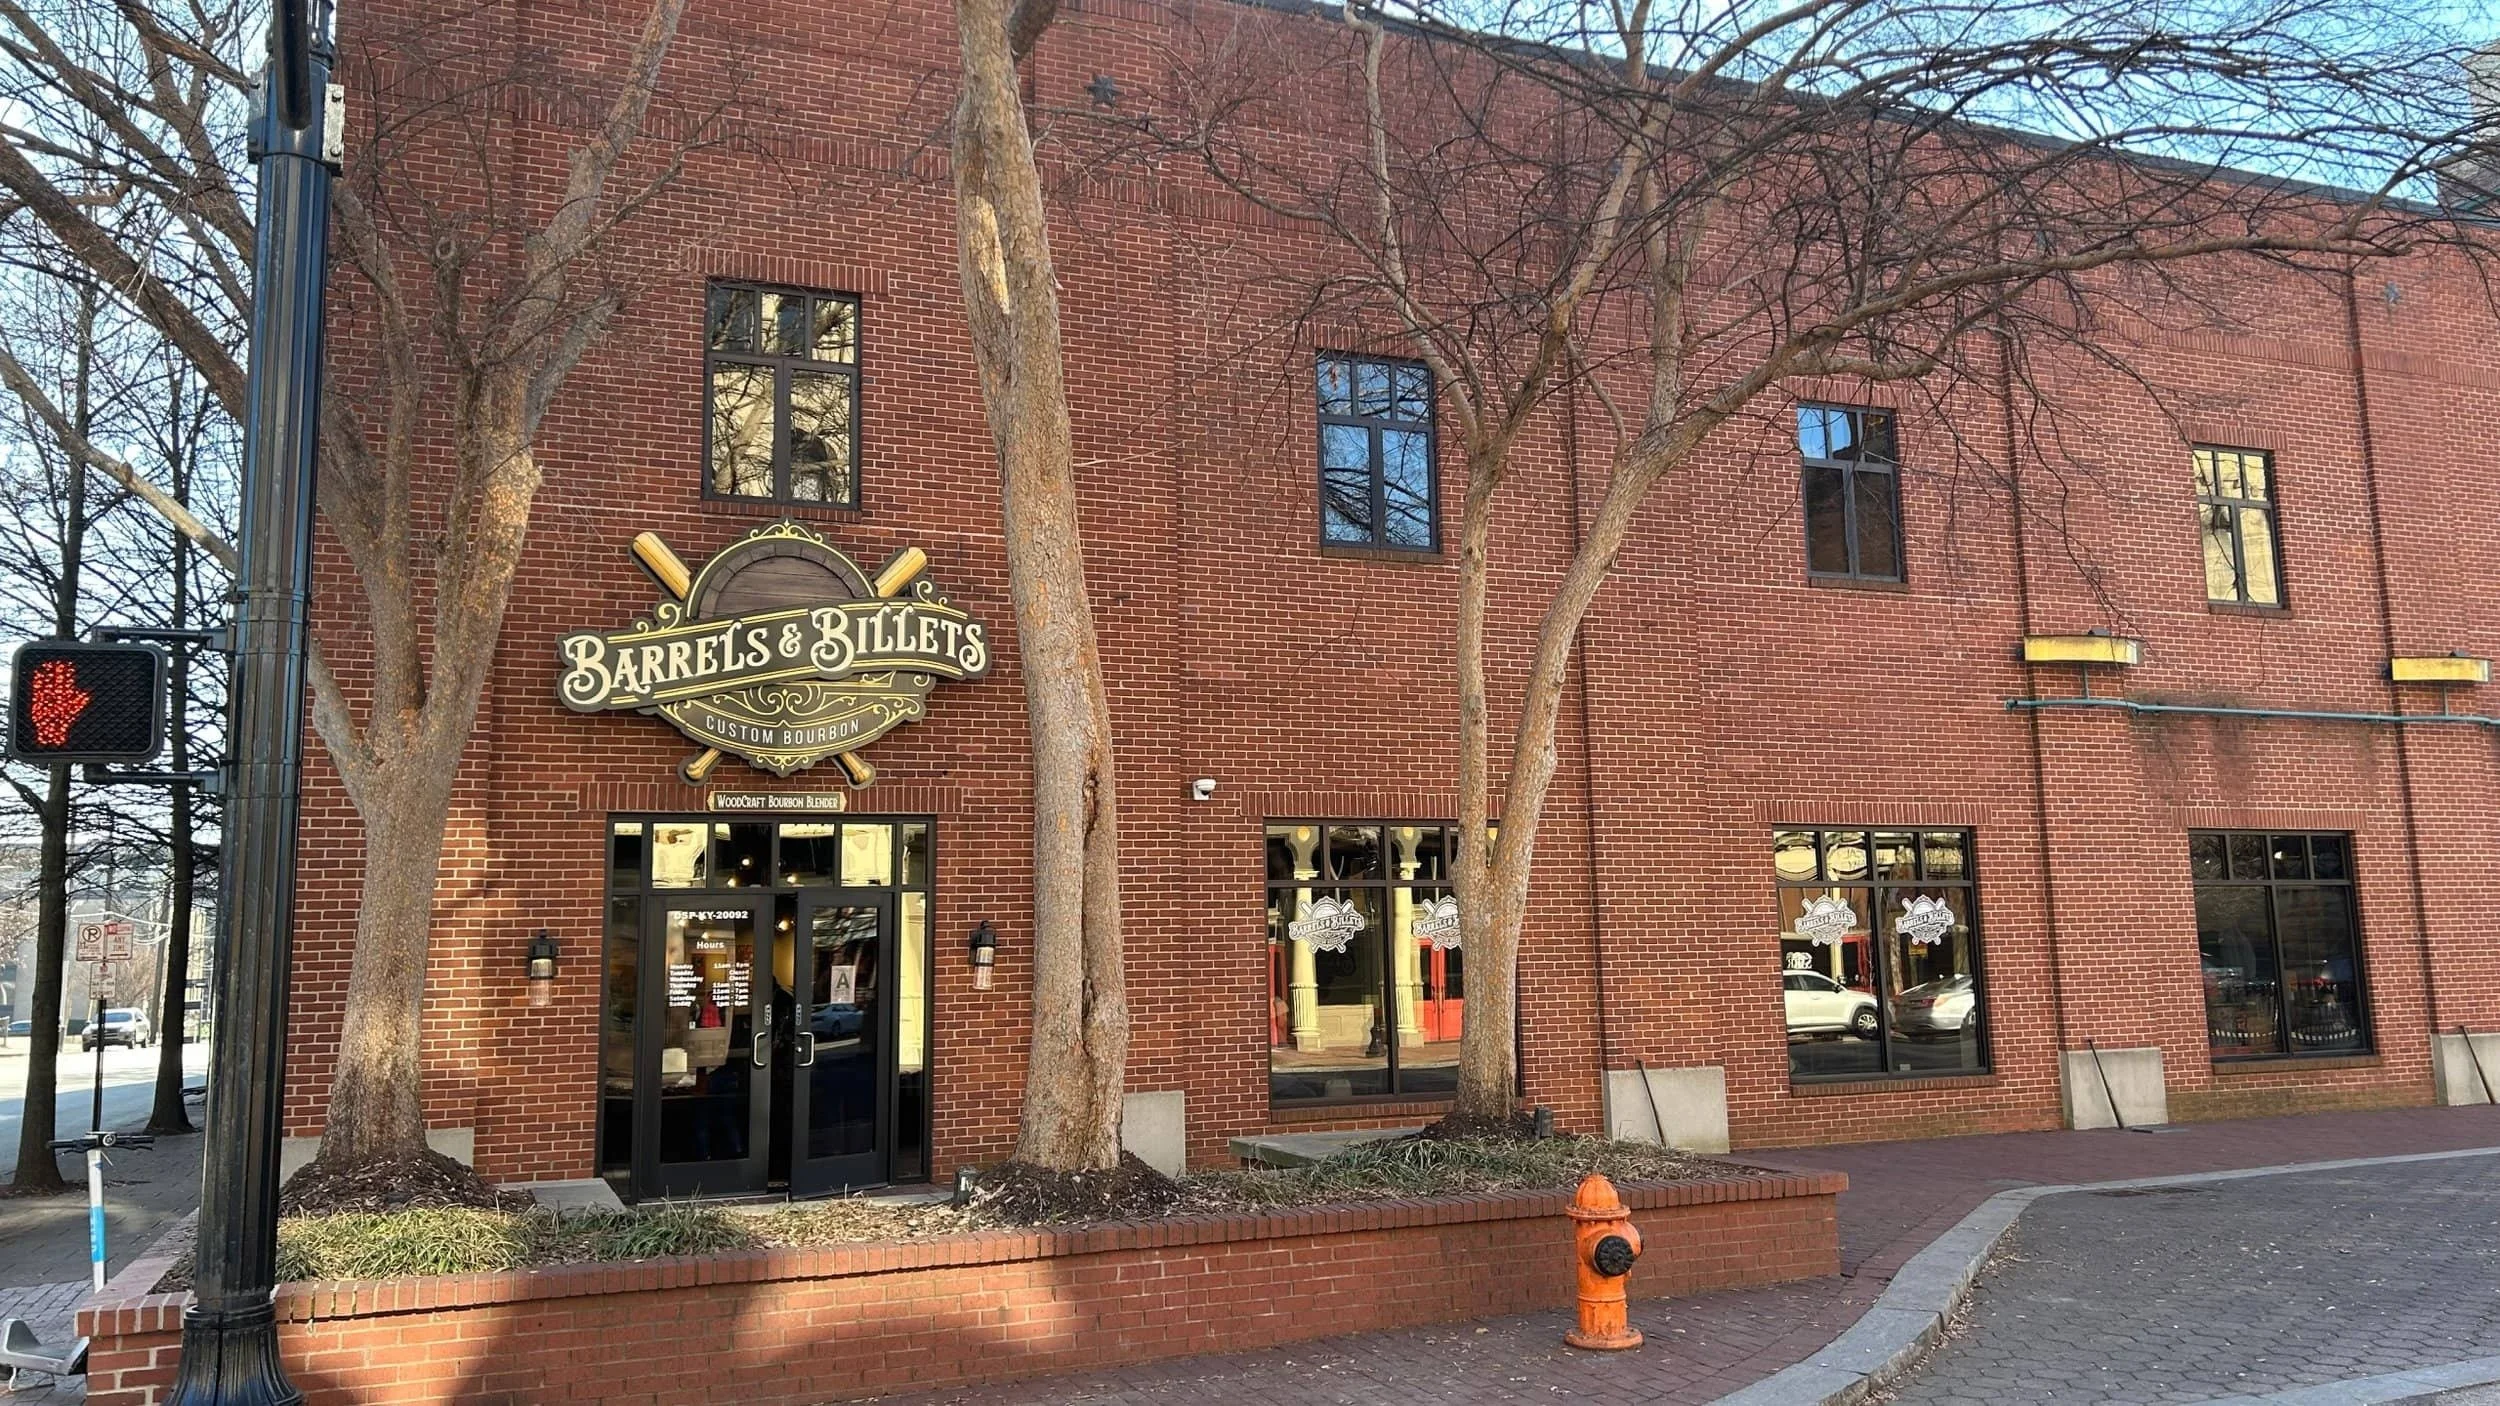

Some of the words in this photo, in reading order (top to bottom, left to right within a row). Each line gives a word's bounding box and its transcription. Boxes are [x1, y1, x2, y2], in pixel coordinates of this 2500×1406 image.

[563, 622, 771, 704] BARRELS
[778, 623, 802, 657] &
[809, 605, 986, 672] BILLETS
[706, 715, 773, 744] CUSTOM
[784, 719, 859, 744] BOURBON
[673, 910, 749, 920] DSP-KY-20092
[696, 941, 725, 949] Hours
[836, 972, 849, 988] A
